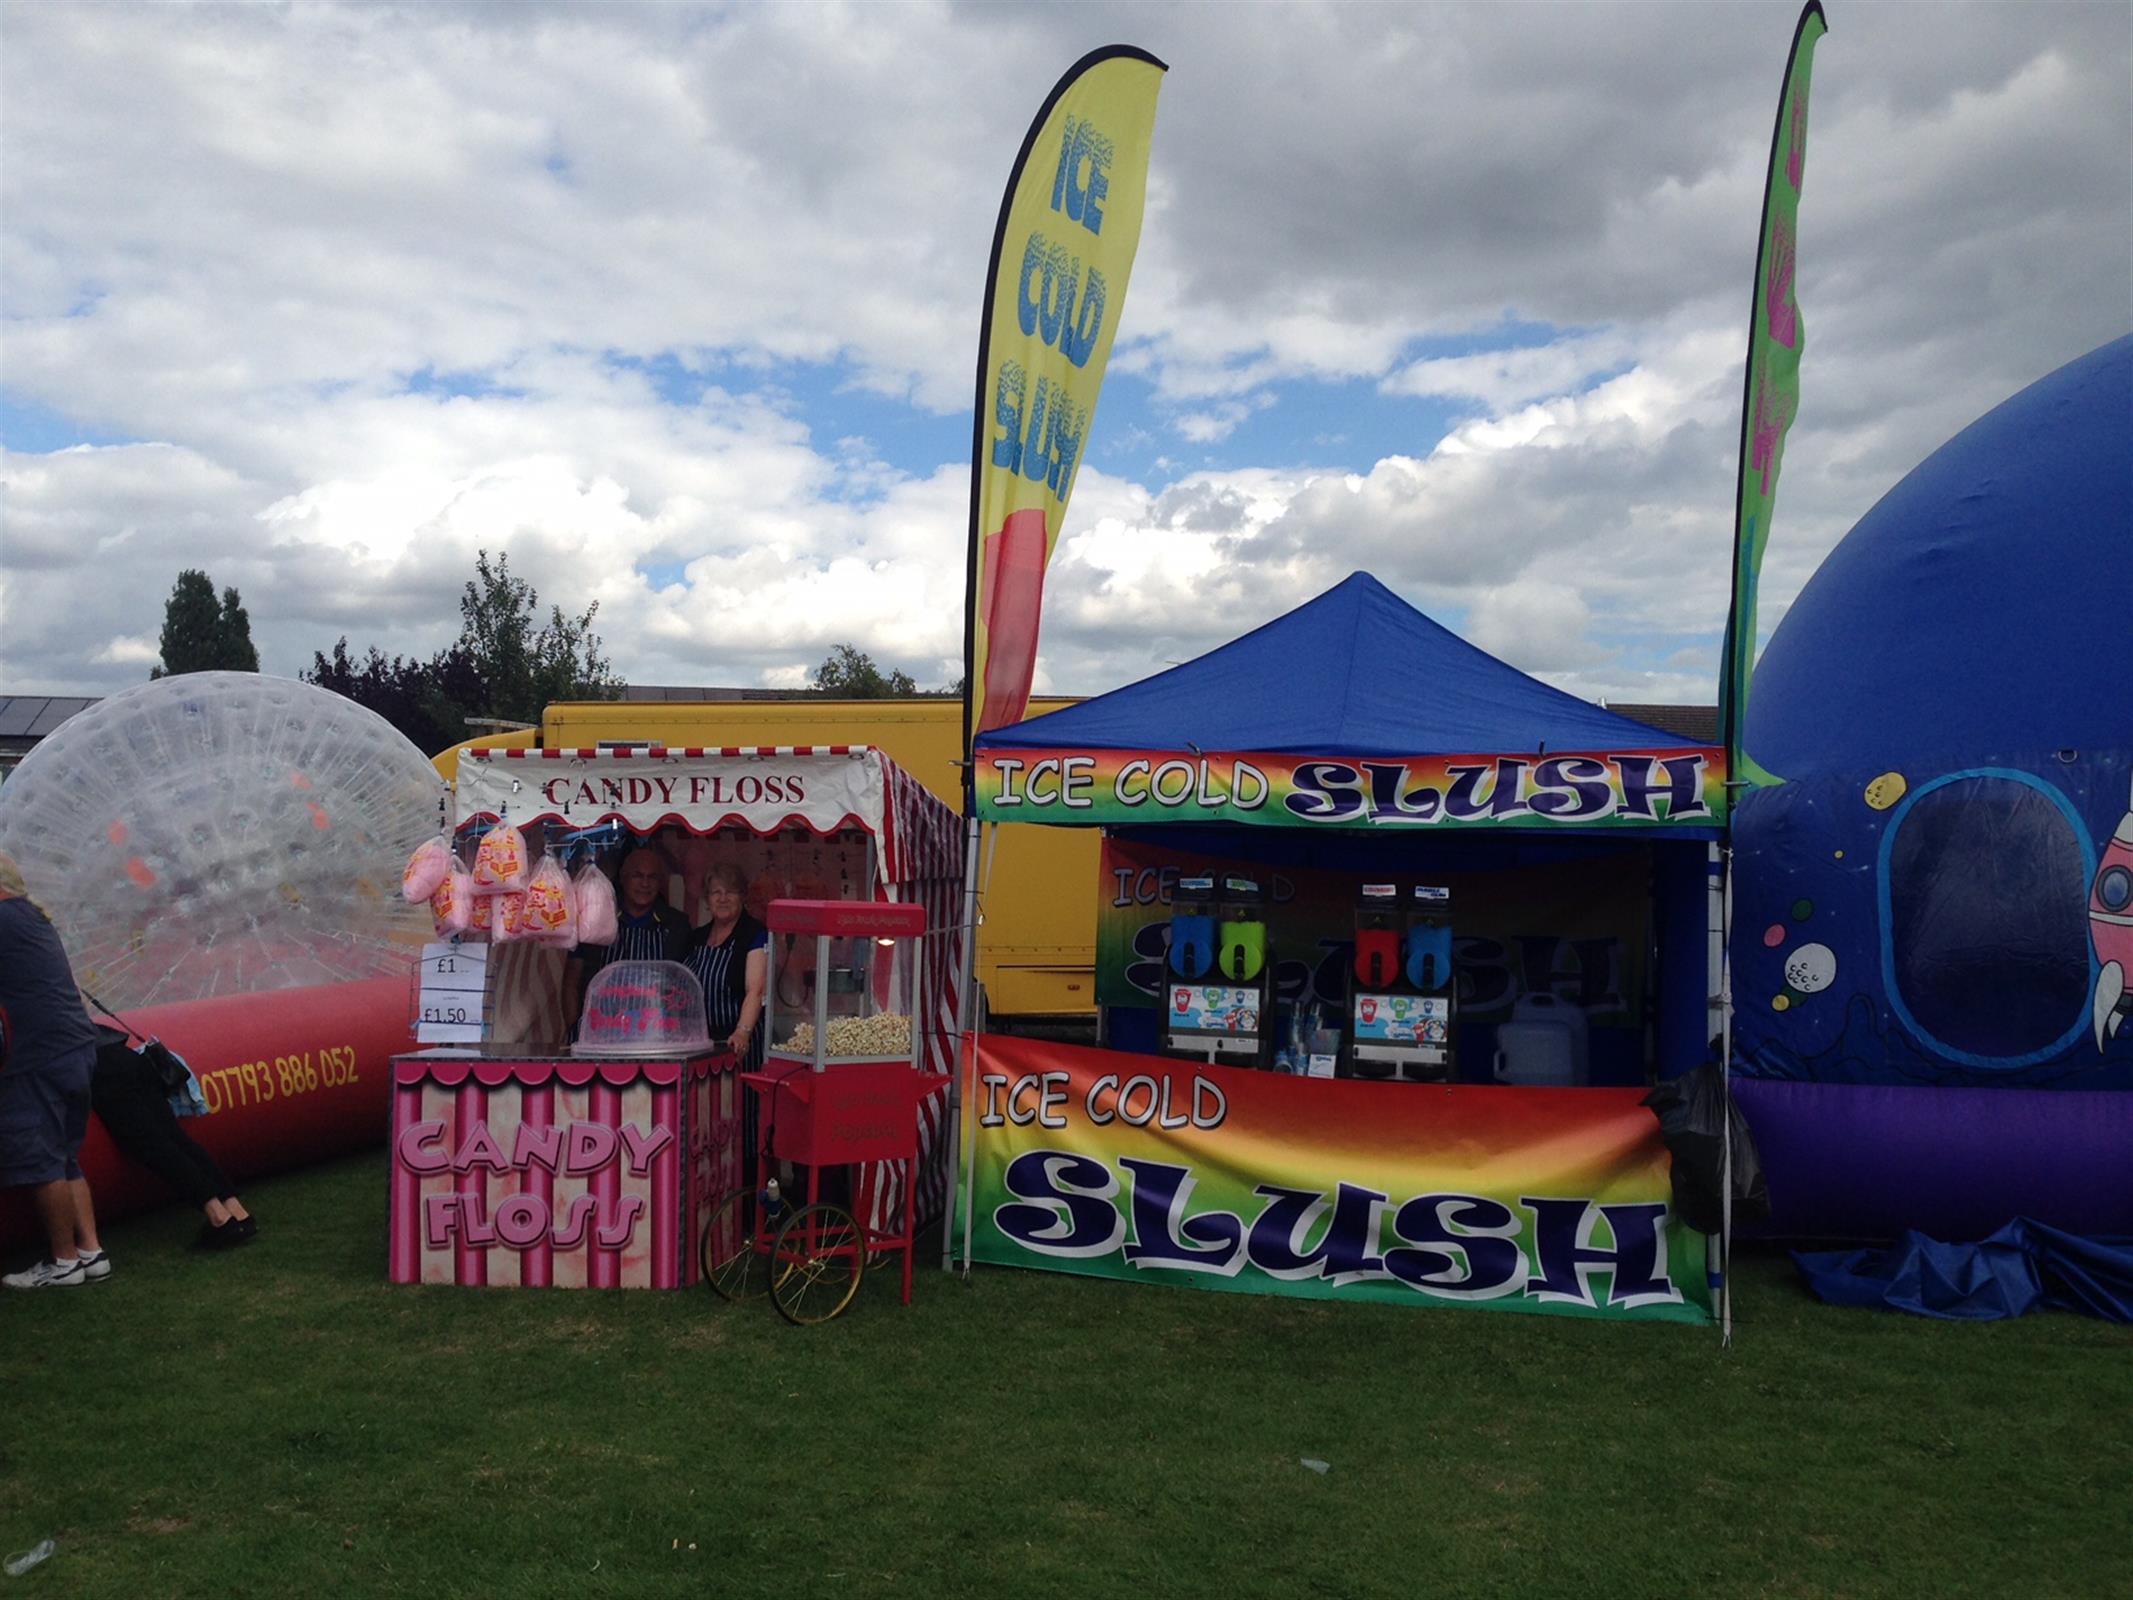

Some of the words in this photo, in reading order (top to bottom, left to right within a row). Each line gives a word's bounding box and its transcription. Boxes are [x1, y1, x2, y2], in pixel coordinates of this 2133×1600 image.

[1050, 113, 1114, 236] ICE
[1017, 231, 1106, 368] COLD
[545, 776, 679, 805] CANDY
[690, 775, 806, 805] FLOSS
[992, 757, 1097, 808] ICE
[1114, 757, 1270, 810] COLD
[1282, 754, 1712, 826] SLUSH
[1113, 865, 1181, 907] ICE
[437, 958, 457, 973] £1
[424, 1007, 467, 1024] £1.50
[200, 1060, 275, 1115] 07793
[275, 1051, 319, 1097] 886
[319, 1045, 359, 1088] 052
[979, 1071, 1071, 1130] ICE
[1085, 1073, 1227, 1131] COLD
[399, 1120, 675, 1177] CANDY
[424, 1192, 647, 1250] FLOSS
[992, 1149, 1685, 1309] SLUSH
